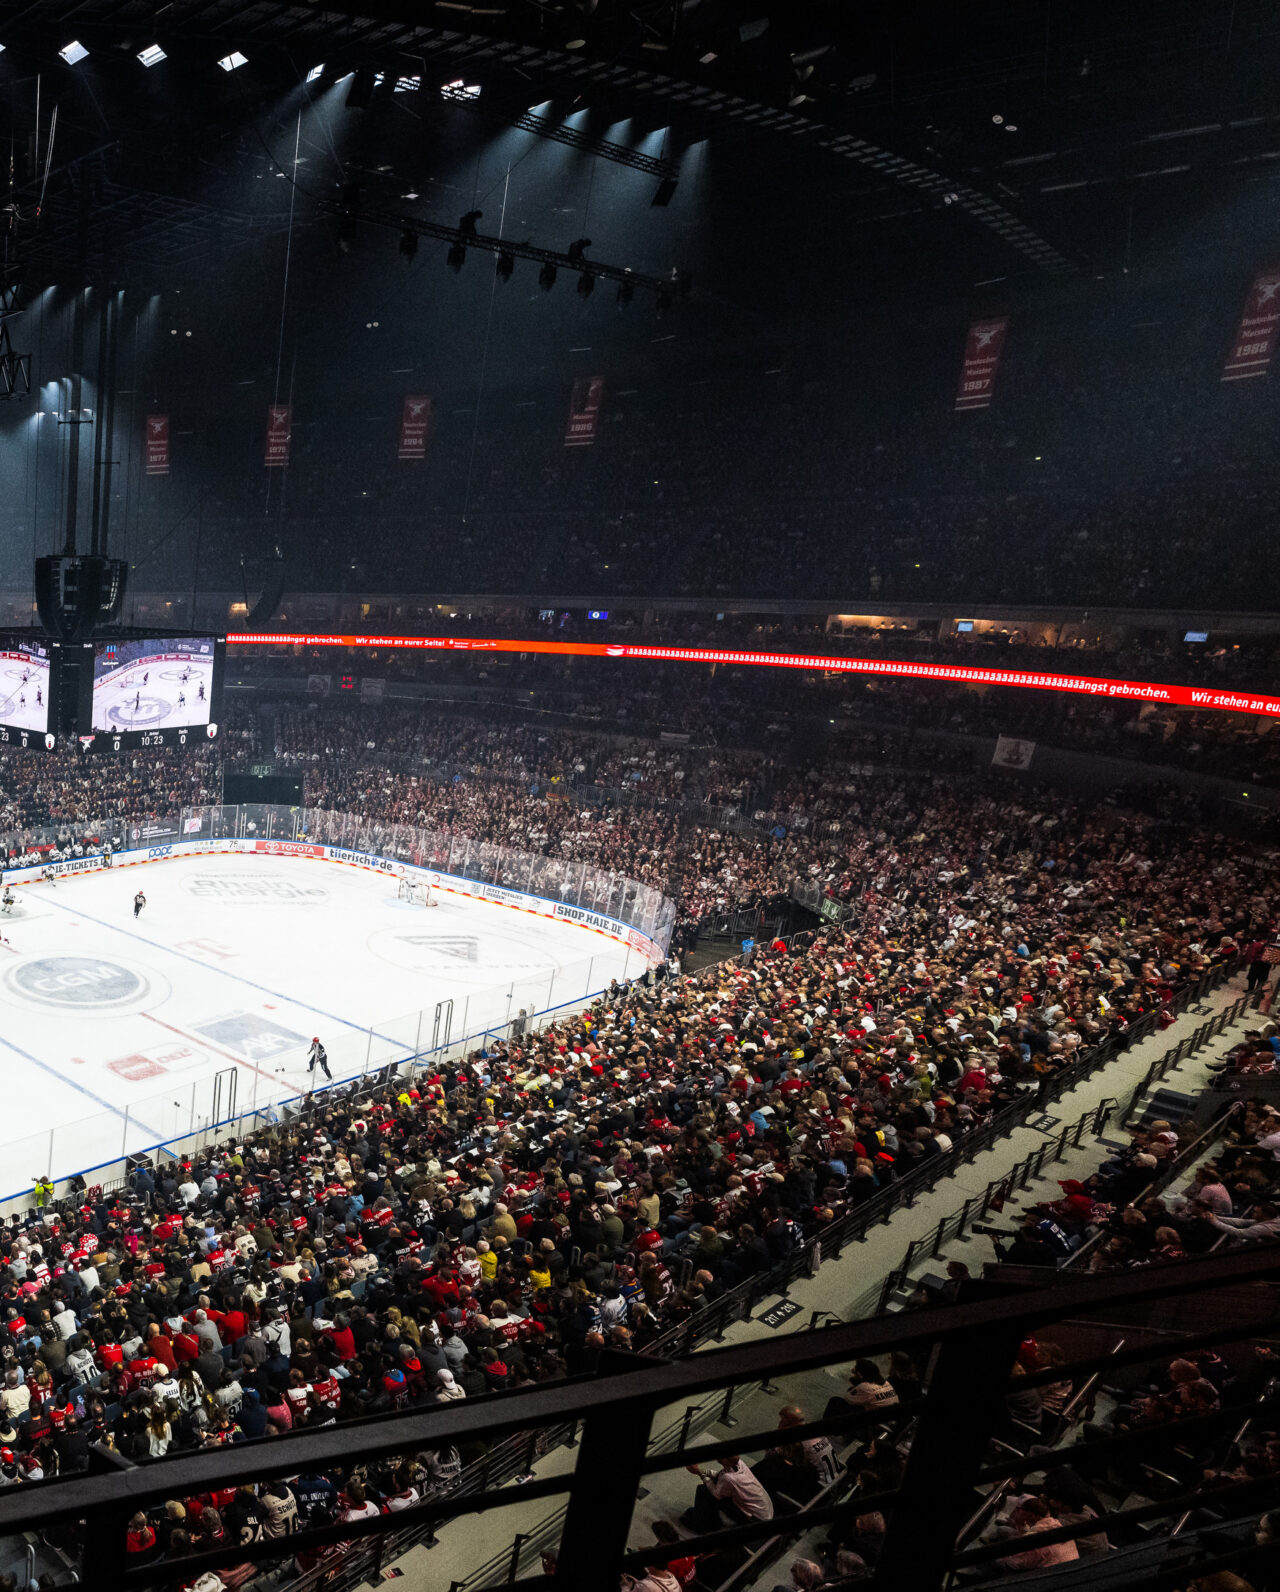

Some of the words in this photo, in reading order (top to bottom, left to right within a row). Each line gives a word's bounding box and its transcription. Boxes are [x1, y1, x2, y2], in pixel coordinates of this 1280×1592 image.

[1235, 341, 1268, 357] 1988
[963, 378, 991, 392] 1987
[306, 636, 345, 645] gebrochen.
[369, 637, 392, 645] stehen
[424, 639, 445, 647] Seite!
[1109, 681, 1170, 699] gebrochen.
[1191, 691, 1213, 703] Wir
[1213, 693, 1249, 707] stehen
[1250, 700, 1264, 711] an
[1266, 702, 1280, 713] eu
[22, 738, 27, 748] 0
[141, 735, 164, 746] 10:23
[180, 734, 186, 744] 0
[113, 741, 120, 751] 0
[280, 843, 315, 854] TOYOTA
[189, 887, 328, 898] Energie
[557, 905, 624, 935] SHOP.HAIE.DE
[33, 966, 122, 992] CGM
[239, 1031, 300, 1059] AXA
[764, 1313, 780, 1325] 217
[80, 1365, 99, 1384] 10
[246, 1515, 259, 1525] SILL
